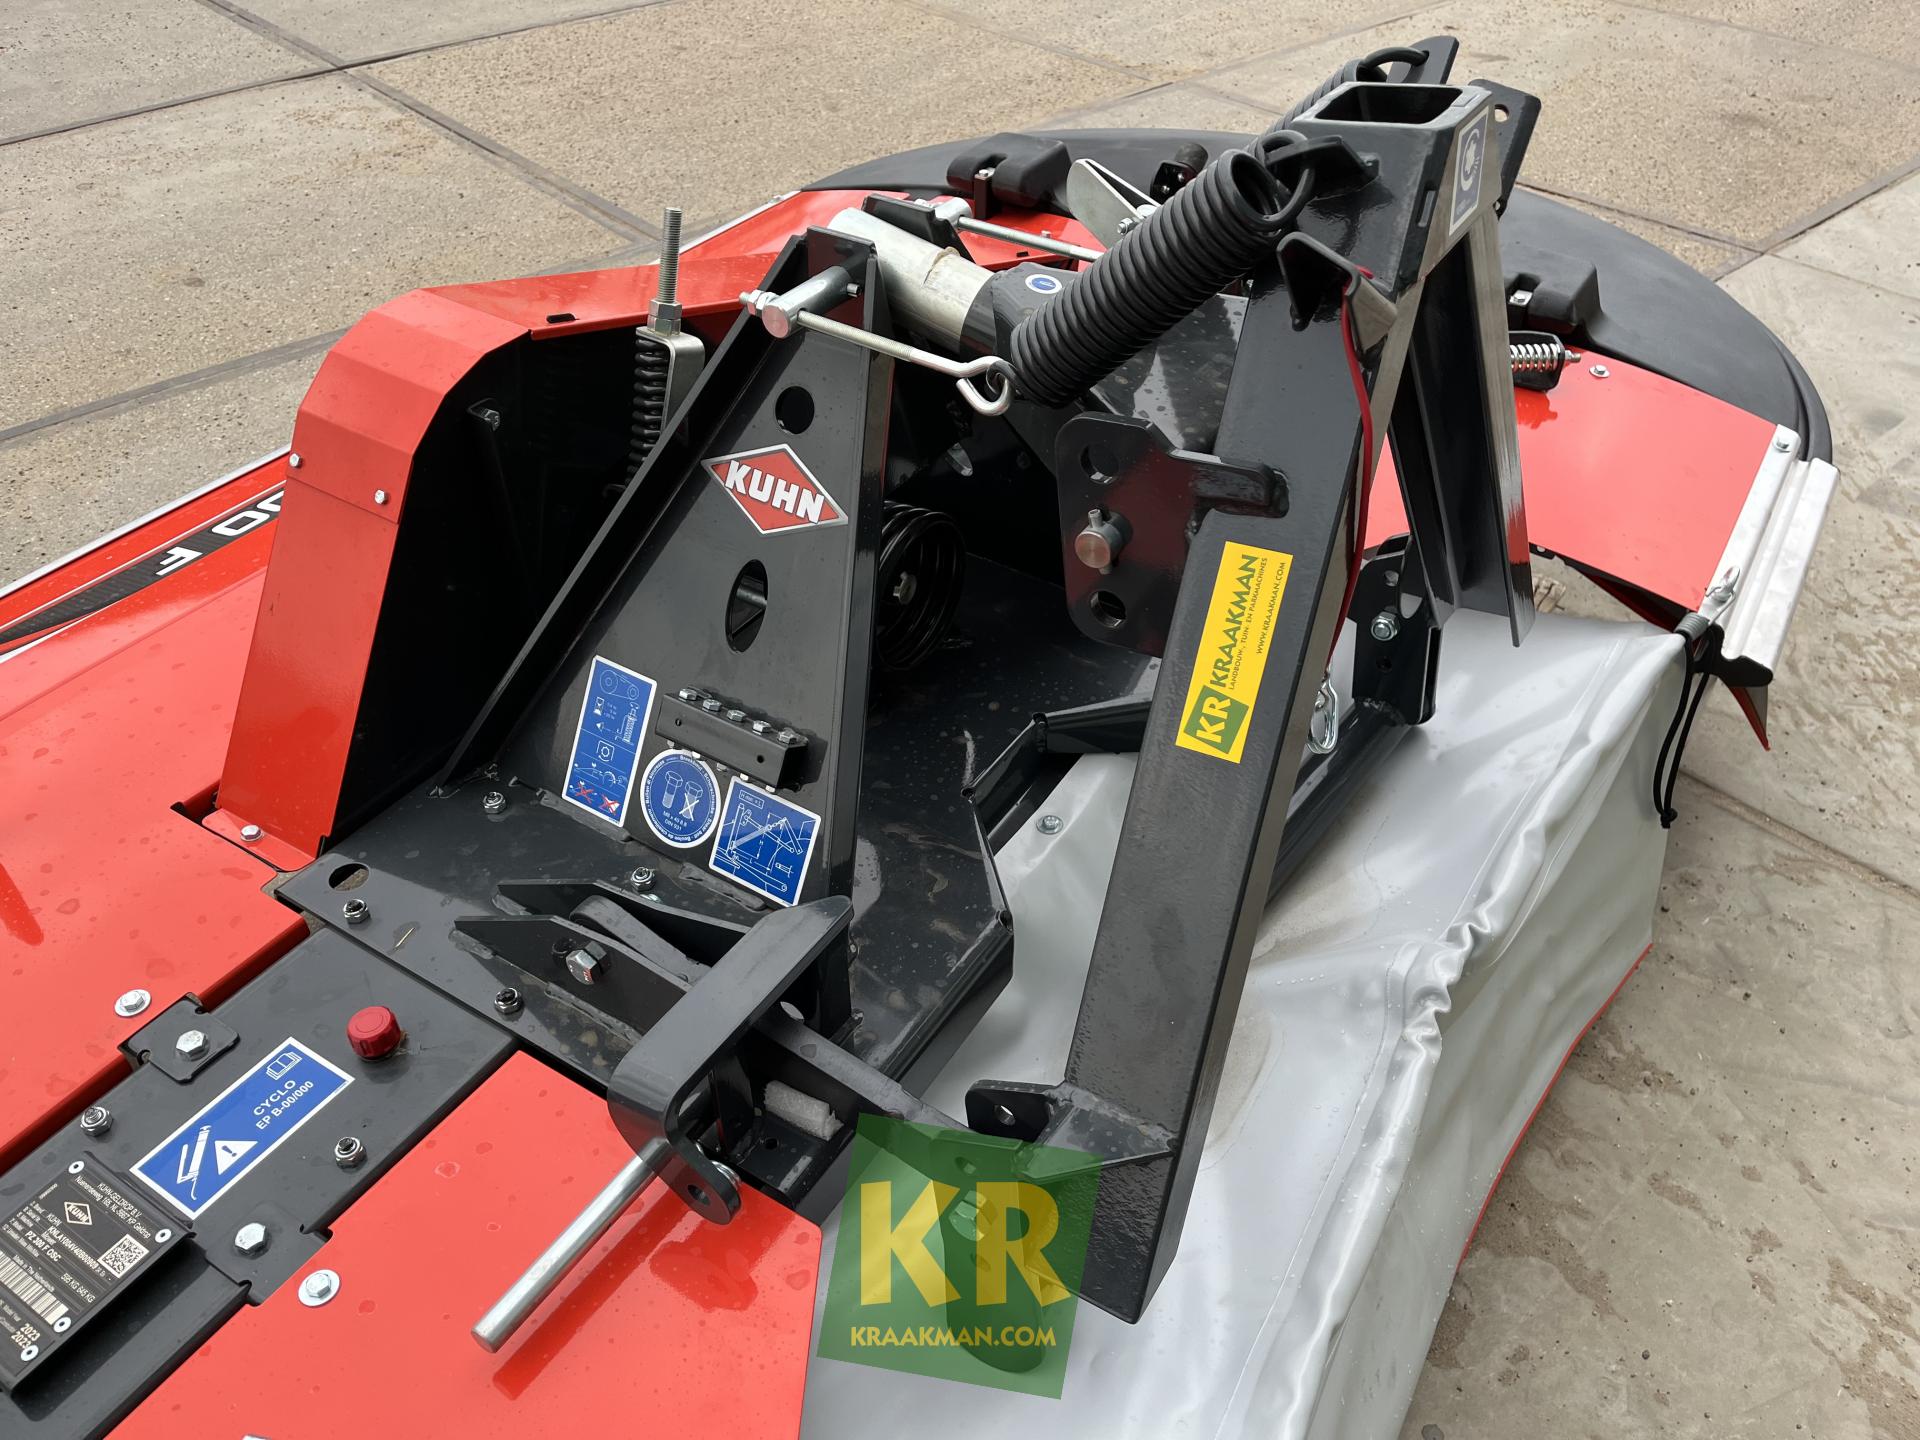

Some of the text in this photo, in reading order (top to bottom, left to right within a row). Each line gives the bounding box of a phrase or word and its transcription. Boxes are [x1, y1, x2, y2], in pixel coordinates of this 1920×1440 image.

[725, 460, 824, 524] KUHN
[155, 546, 203, 576] F
[1248, 557, 1268, 612] PARKMACHINES
[1210, 553, 1260, 687] KRAAKMAN
[1245, 608, 1253, 623] EN
[1256, 562, 1286, 654] WWW.KRAAKMAN.COM
[1196, 696, 1231, 743] KR
[664, 818, 674, 827] DIN
[253, 1080, 297, 1116] CYCLO
[256, 1115, 272, 1130] EP
[271, 1080, 314, 1118] B-00/000
[97, 1182, 135, 1213] KUHN-GELDROP
[46, 1212, 62, 1227] KUHN
[67, 1204, 89, 1223] KUHN
[126, 1217, 137, 1225] KP
[133, 1222, 151, 1239] Geldrop
[24, 1230, 37, 1241] PZ
[32, 1237, 45, 1248] 300
[41, 1244, 49, 1252] F
[46, 1248, 62, 1262] OSC
[68, 1279, 80, 1290] KG
[76, 1285, 88, 1297] 645
[84, 1293, 96, 1304] KG
[11, 1330, 32, 1350] 2023
[20, 1322, 41, 1341] 2023
